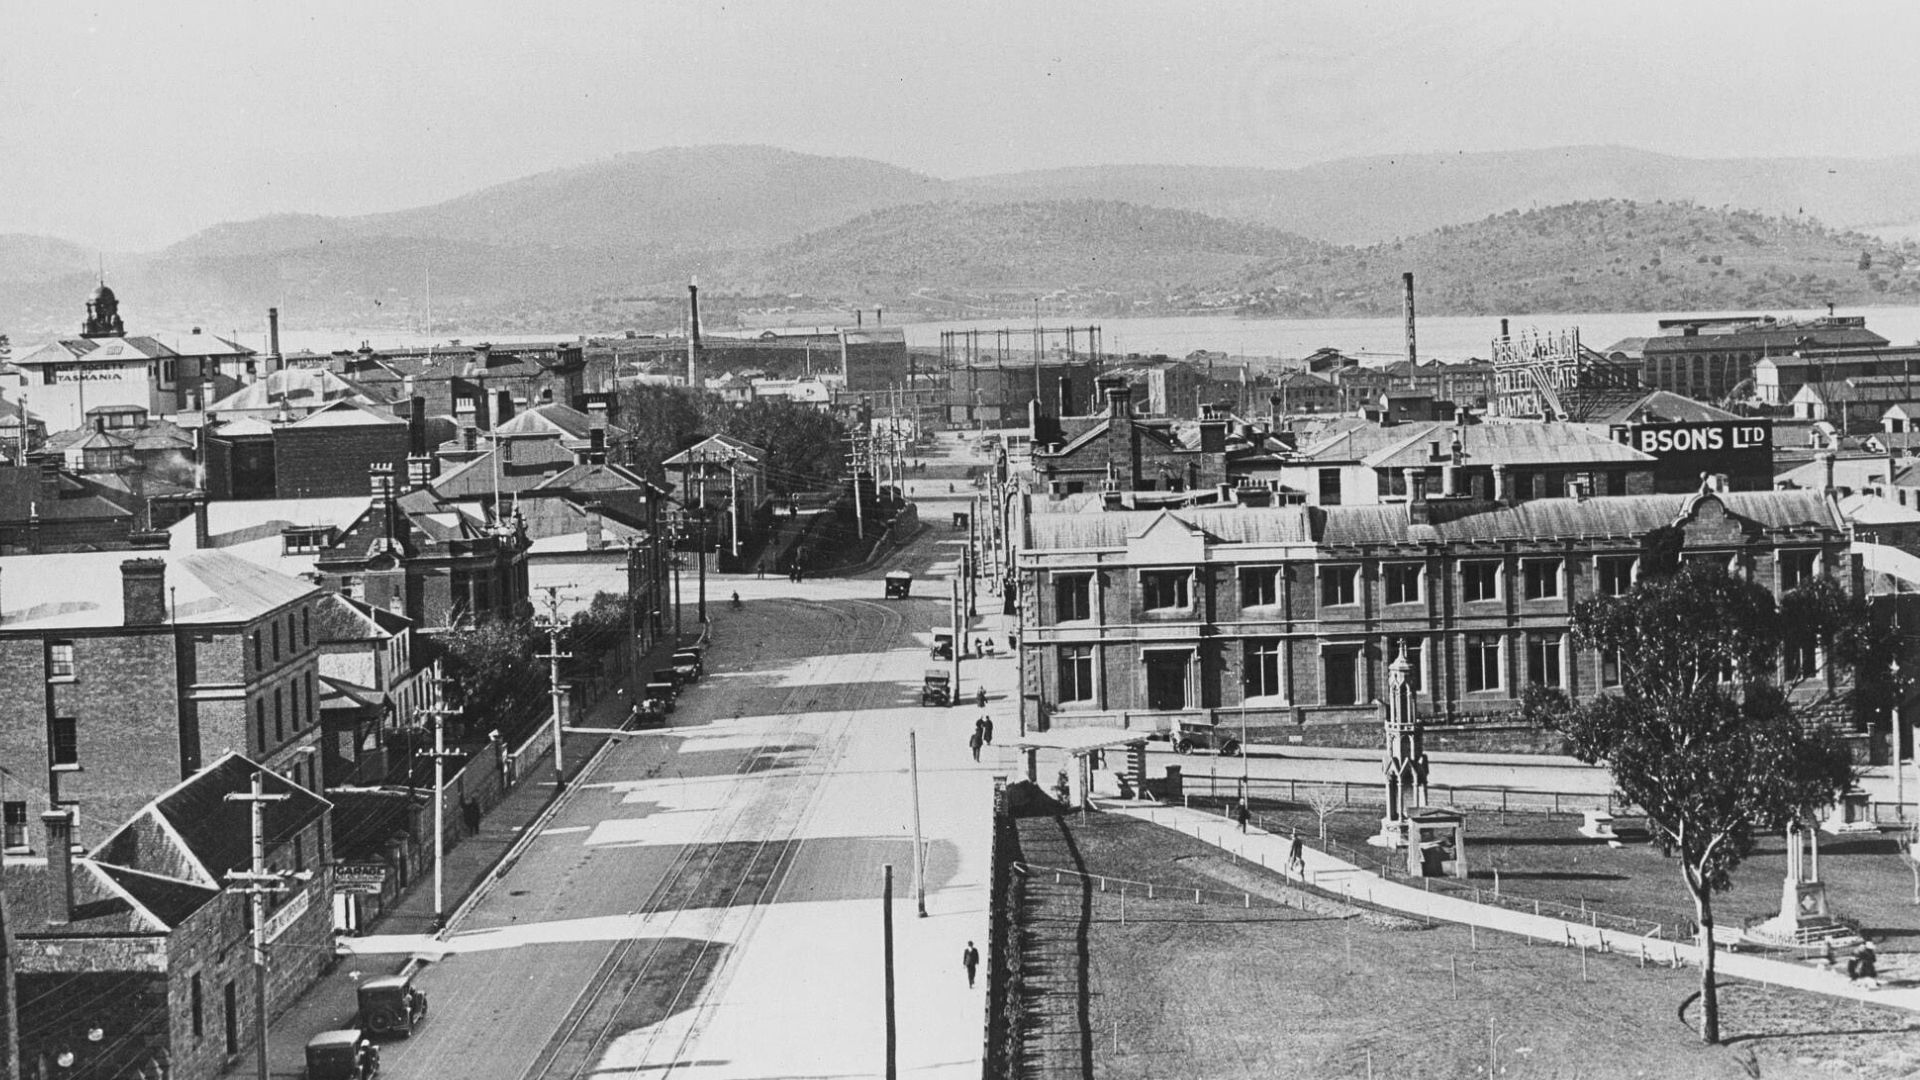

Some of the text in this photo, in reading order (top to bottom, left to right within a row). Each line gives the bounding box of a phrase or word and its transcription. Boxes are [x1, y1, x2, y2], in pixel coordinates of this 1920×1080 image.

[1495, 366, 1577, 394] ROLLED OATS
[1732, 427, 1765, 448] LTD
[337, 866, 383, 875] GARAGE
